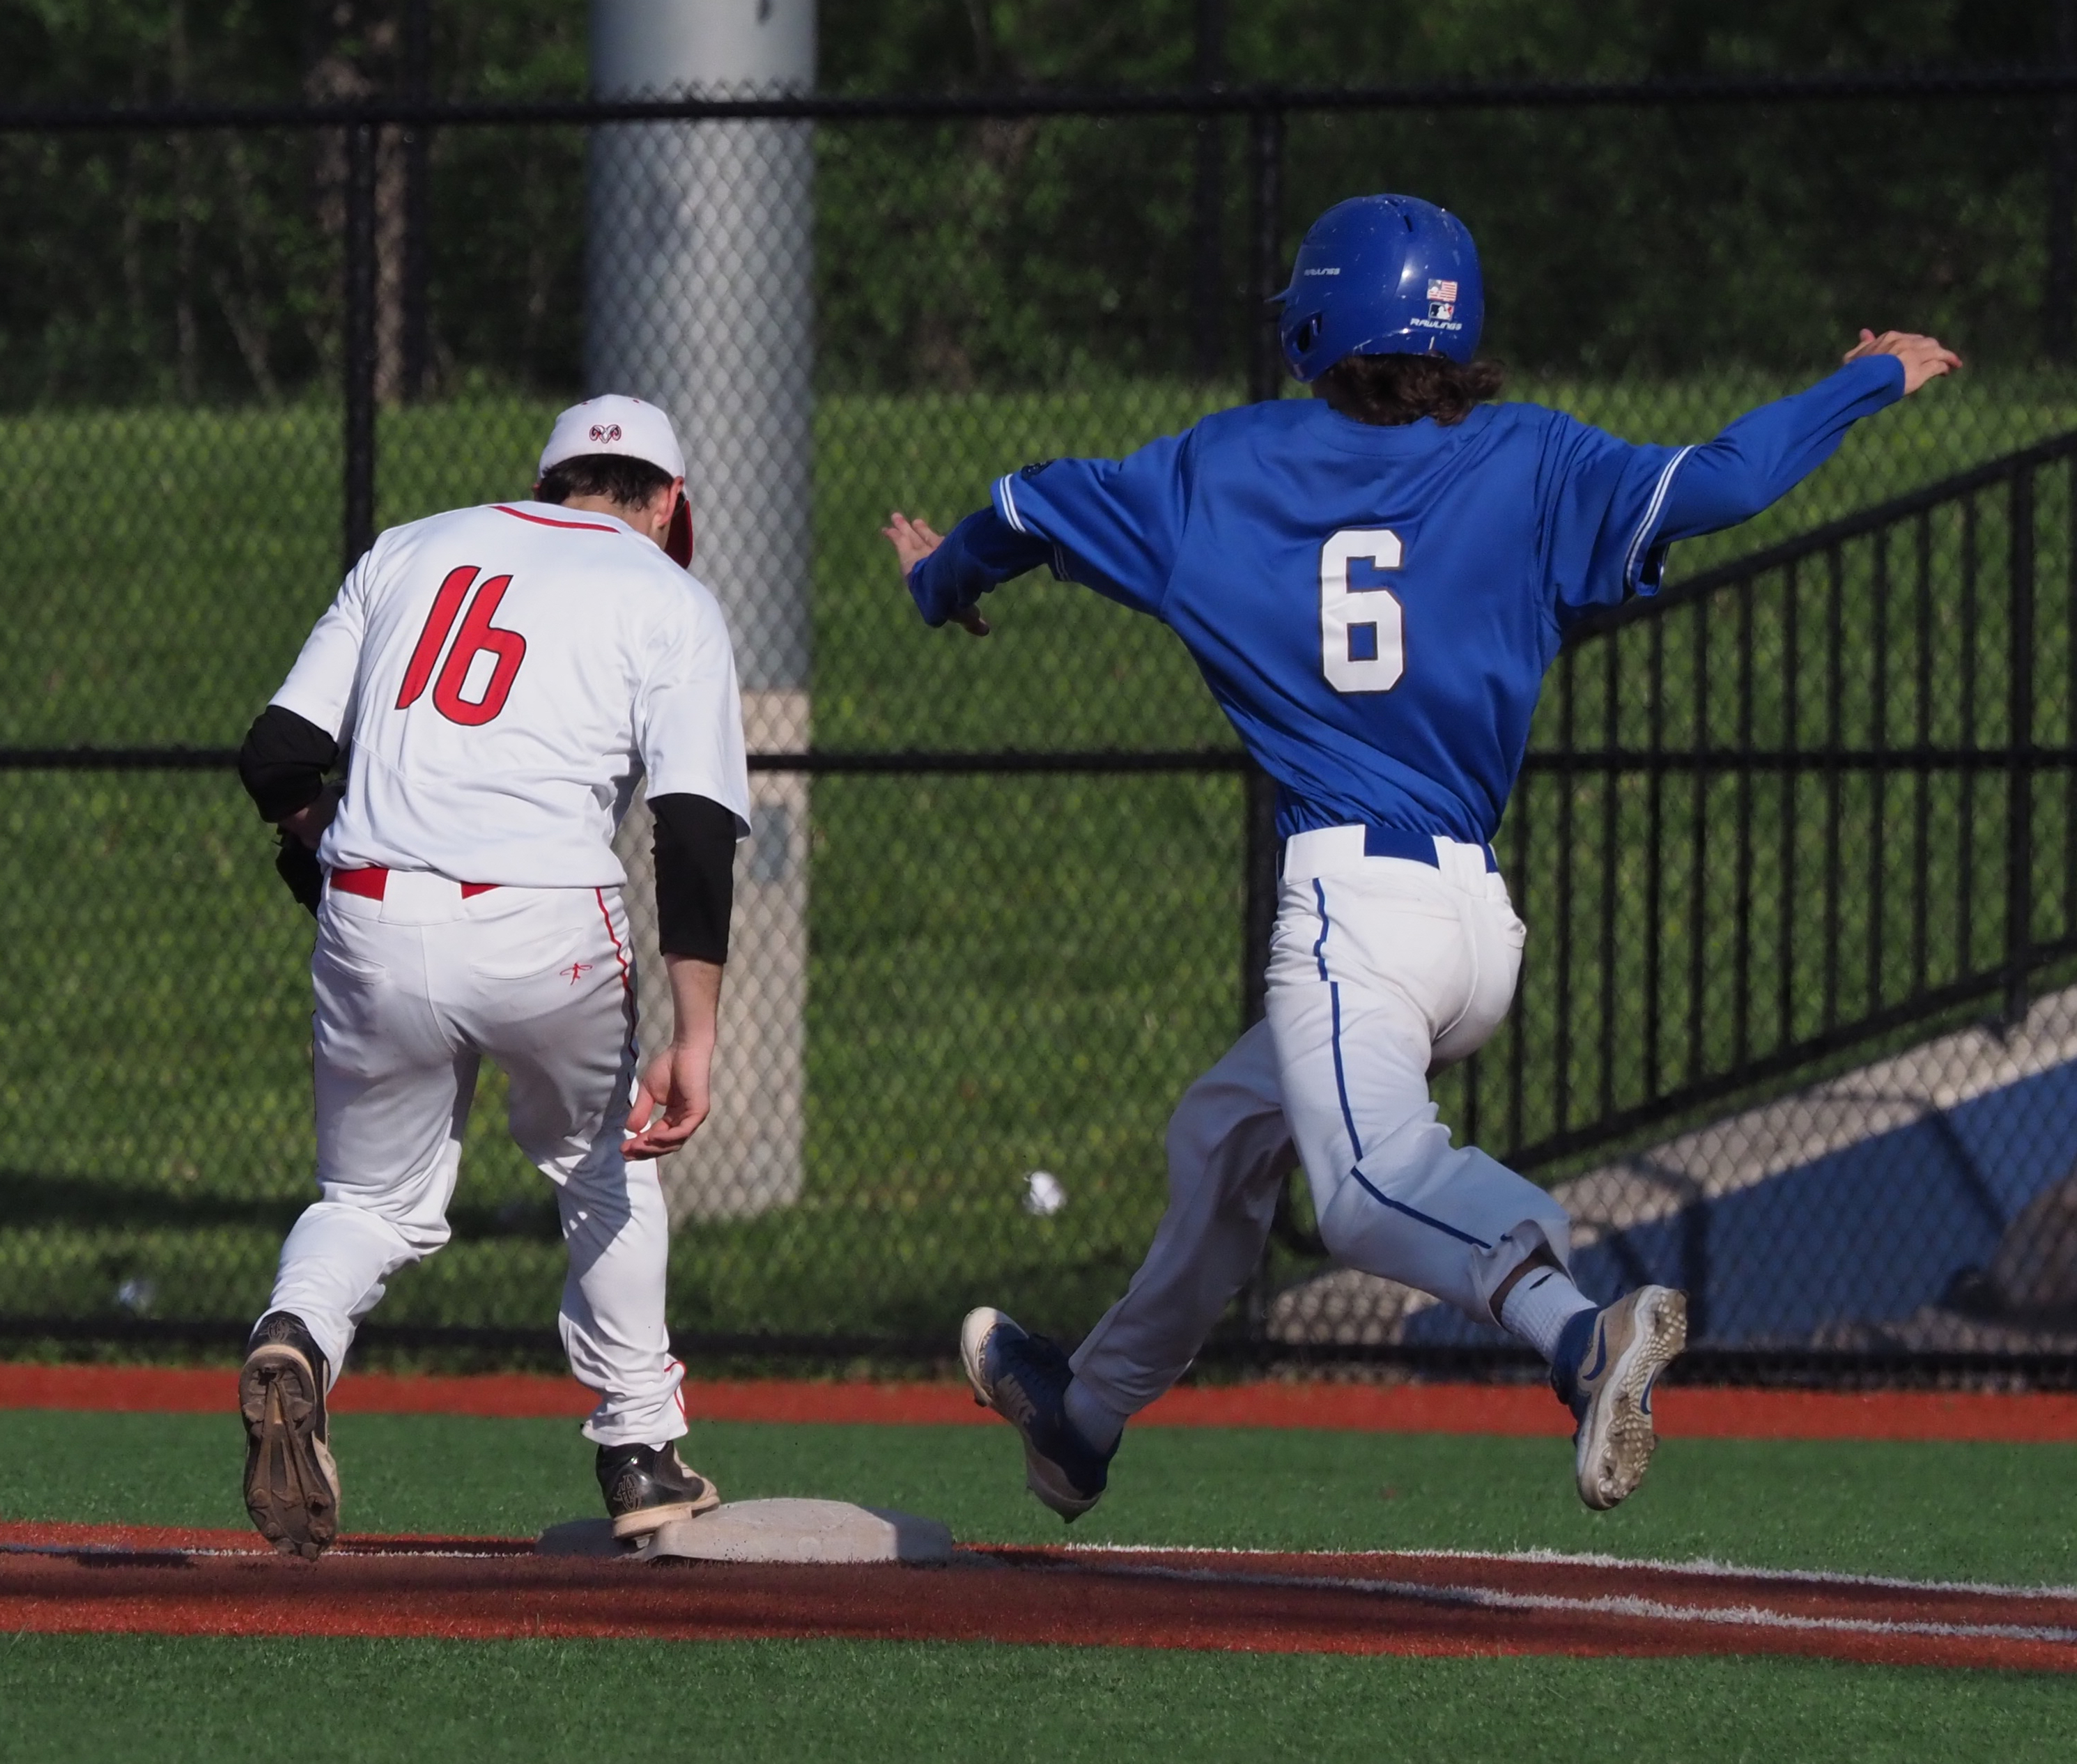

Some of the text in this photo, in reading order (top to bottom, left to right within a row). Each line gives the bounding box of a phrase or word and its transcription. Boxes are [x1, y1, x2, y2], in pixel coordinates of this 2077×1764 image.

[1410, 318, 1462, 331] RAWLINGS
[394, 565, 527, 727] 16
[1320, 529, 1405, 693] 6
